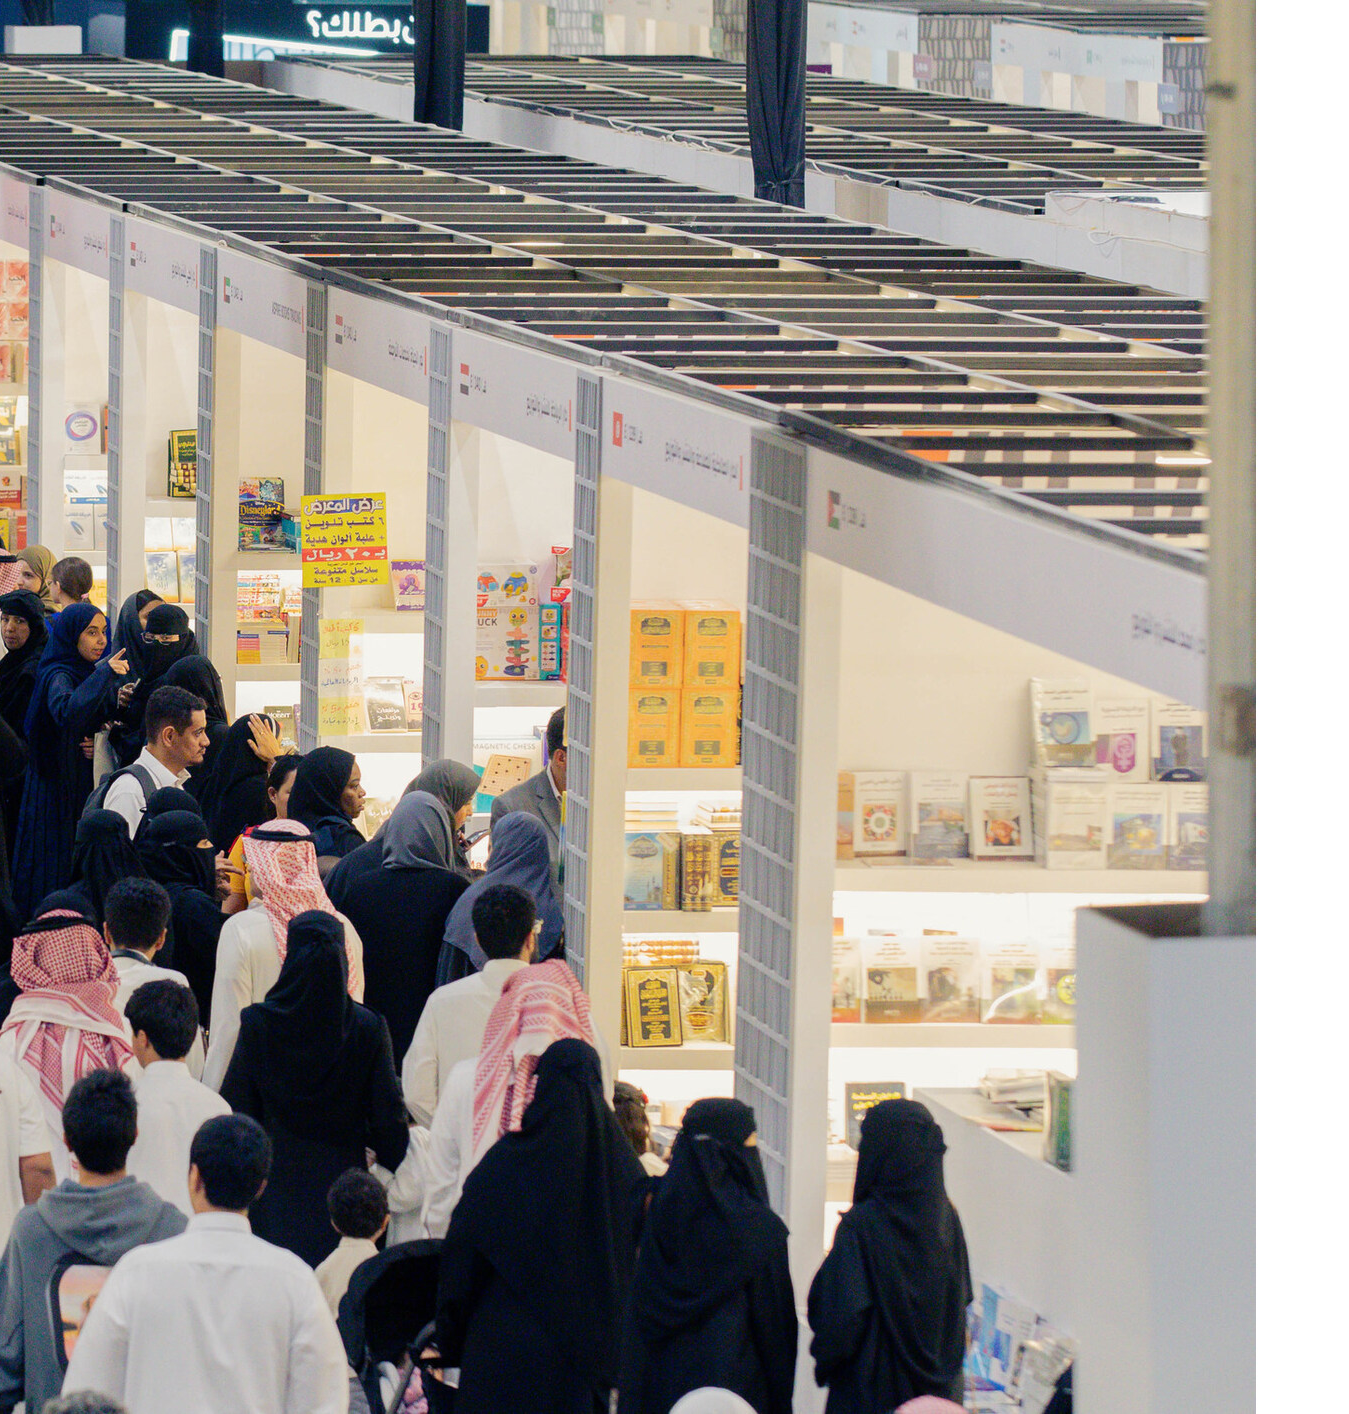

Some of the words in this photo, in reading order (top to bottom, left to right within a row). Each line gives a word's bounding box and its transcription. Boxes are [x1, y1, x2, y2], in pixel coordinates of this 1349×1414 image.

[306, 10, 402, 44] بطلك؟
[304, 498, 350, 516] المعرض
[351, 498, 384, 515] عرض
[304, 517, 344, 531] تلوين
[346, 516, 375, 529] كتب
[305, 533, 328, 547] هدية
[330, 532, 352, 545] ألوان
[355, 532, 375, 545] علبة
[305, 549, 343, 562] ريال
[314, 567, 347, 577] متنوعة
[350, 566, 379, 576] سلاسل
[477, 618, 498, 626] UCK
